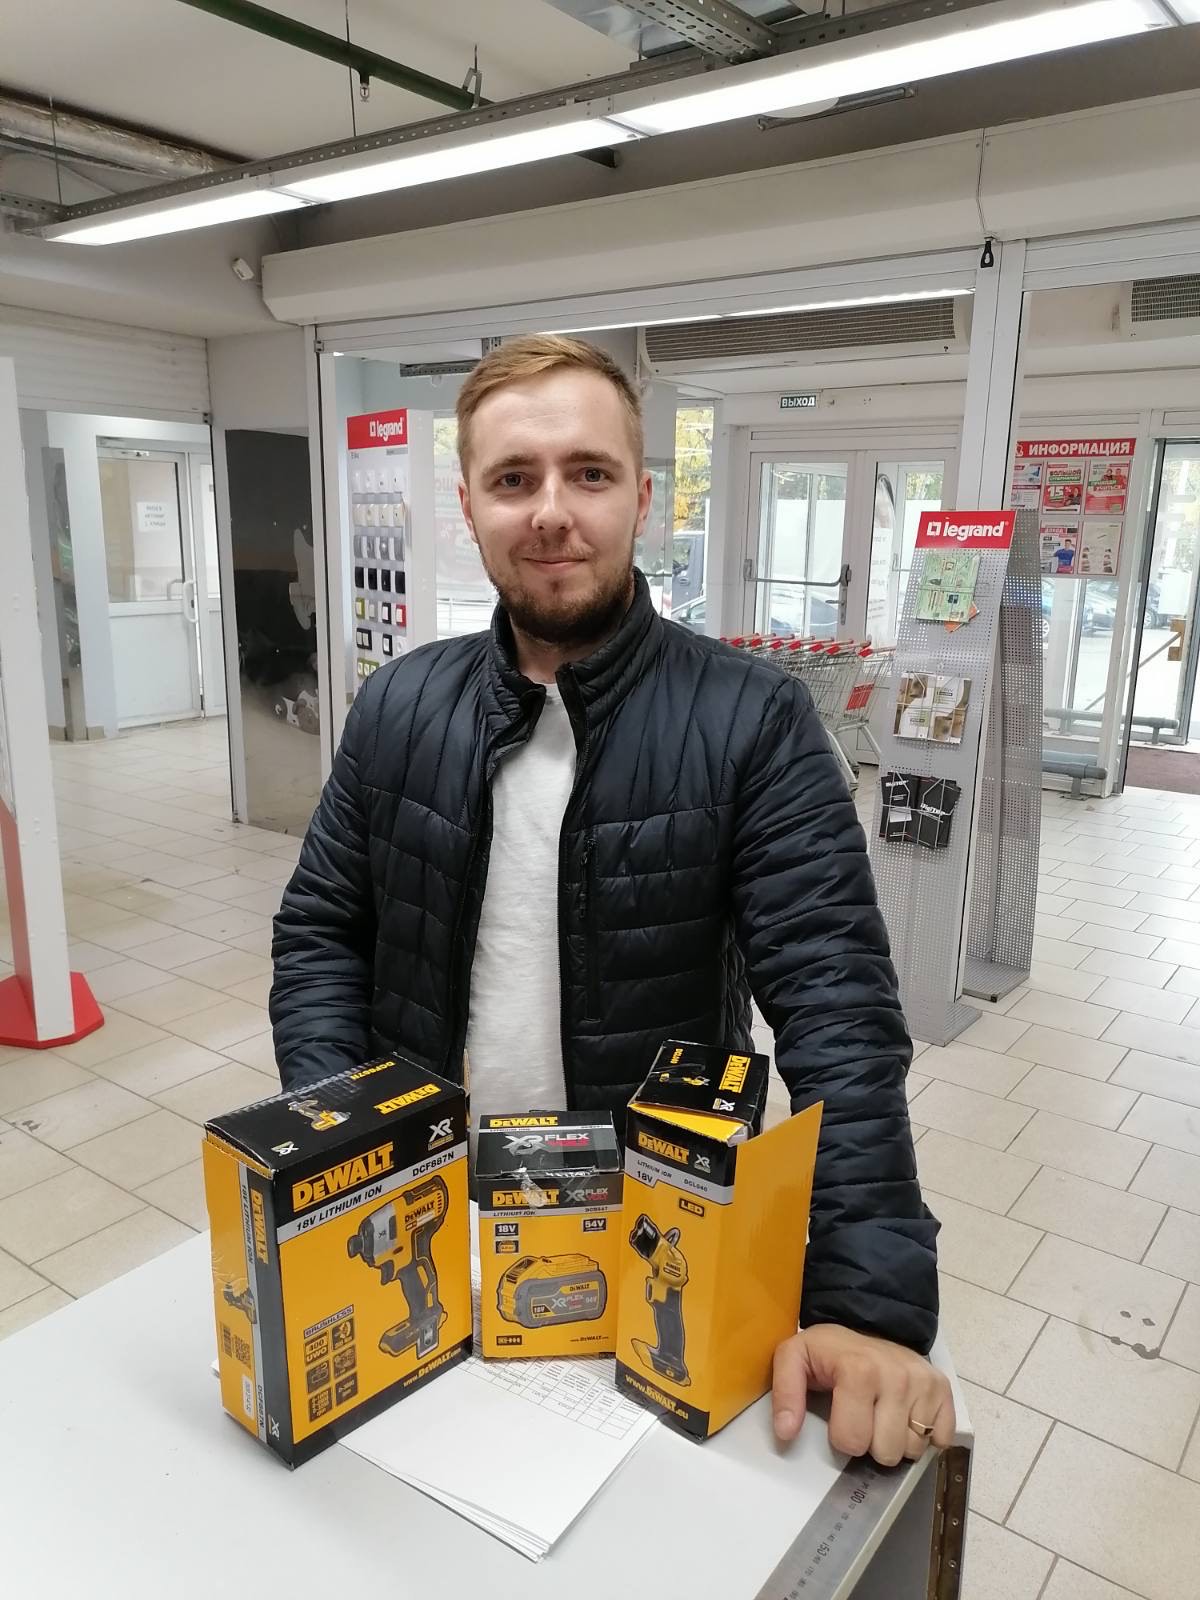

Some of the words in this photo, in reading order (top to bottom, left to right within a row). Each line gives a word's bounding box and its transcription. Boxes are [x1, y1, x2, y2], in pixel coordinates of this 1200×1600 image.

[781, 396, 815, 407] ВЫХОД
[377, 417, 403, 441] legrand
[1029, 442, 1131, 456] ИНФОРМАЦИЯ
[943, 521, 1004, 541] legrand
[428, 1117, 453, 1142] XR
[545, 1132, 590, 1141] FLEX
[412, 1151, 454, 1177] DCF887N
[637, 1159, 661, 1174] LITHIUM
[661, 1169, 672, 1178] ION
[695, 1153, 711, 1169] XR
[636, 1170, 653, 1184] 18V
[565, 1190, 586, 1202] XR
[296, 1213, 317, 1231] 18V
[319, 1193, 363, 1223] LITHIUM
[364, 1184, 383, 1202] ION
[680, 1199, 704, 1216] LED
[497, 1225, 517, 1234] 18V
[585, 1219, 605, 1229] 54V
[305, 1307, 352, 1337] BRUSHLESS
[850, 1488, 867, 1504] 100
